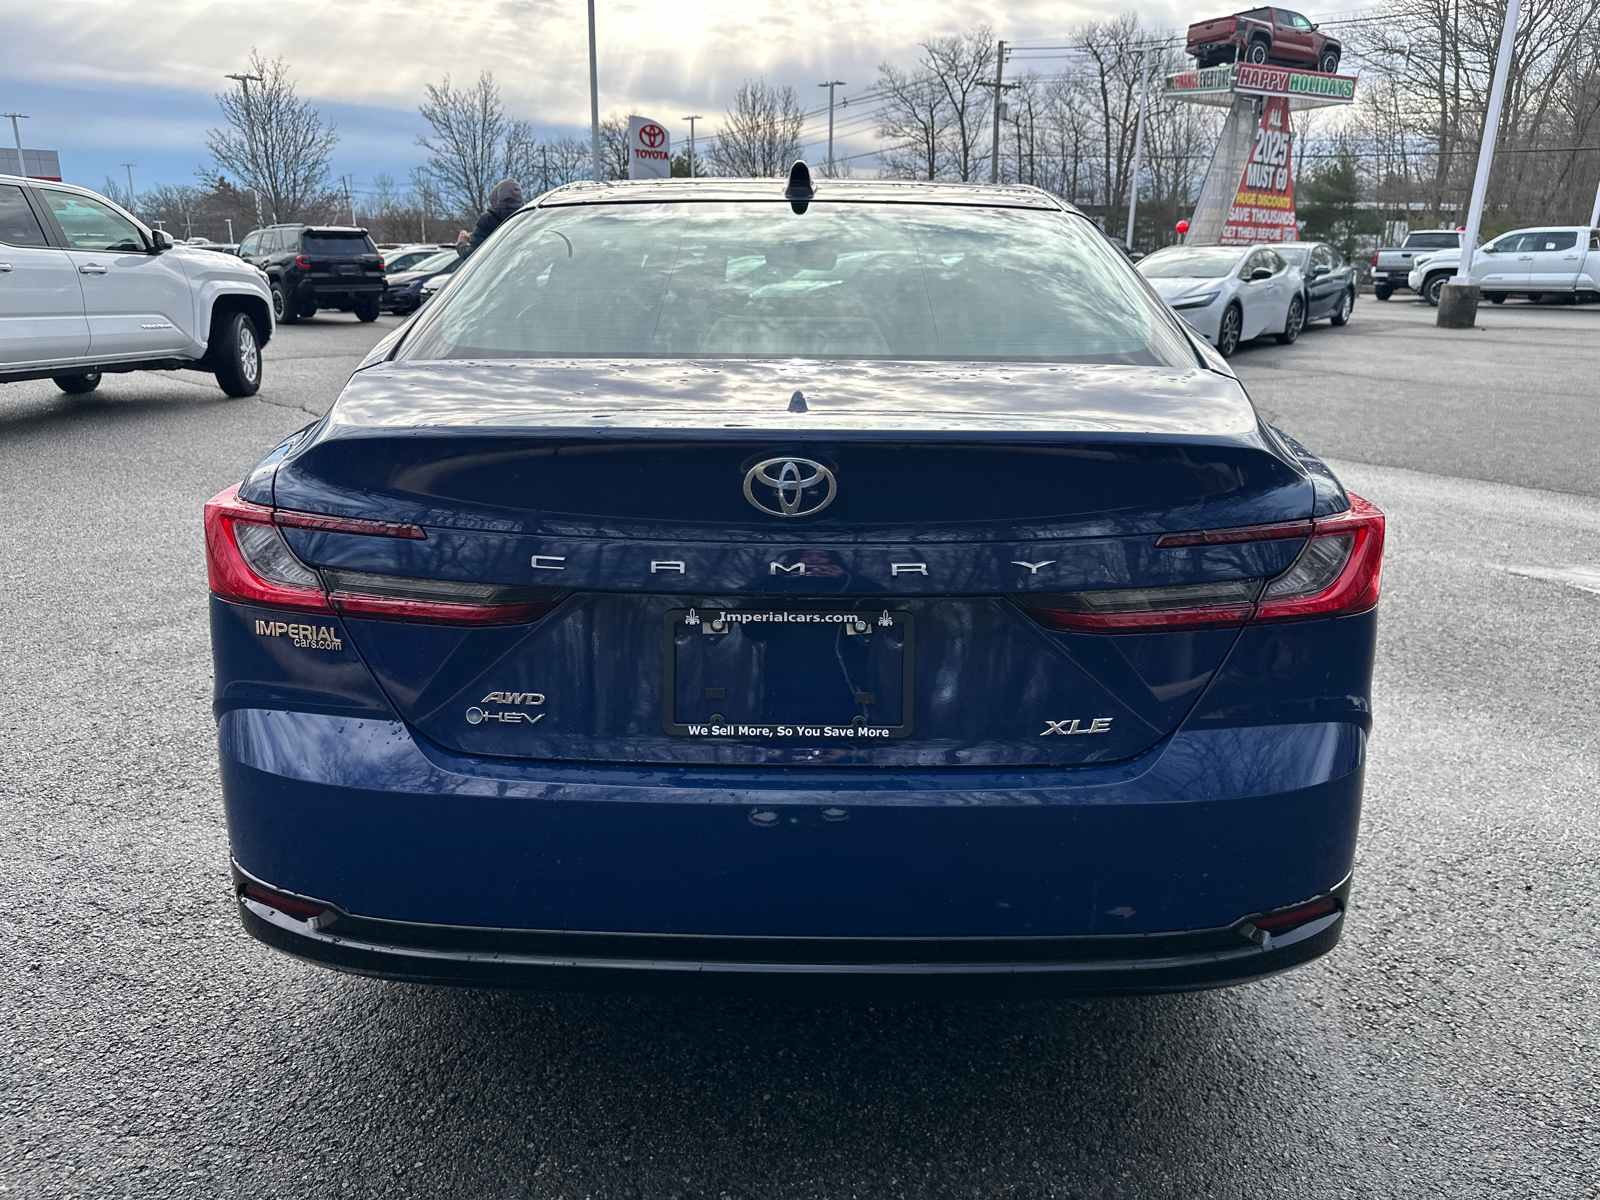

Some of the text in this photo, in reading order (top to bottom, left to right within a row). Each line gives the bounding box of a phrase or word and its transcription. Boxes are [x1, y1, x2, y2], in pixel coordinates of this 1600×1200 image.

[1238, 67, 1353, 97] HAPPY HOLIDAYS
[1269, 108, 1282, 127] ALL
[635, 149, 669, 160] TOYOTA
[1253, 128, 1289, 166] 2025
[1246, 163, 1288, 191] MUST GO
[1236, 192, 1291, 209] HUGE DISCOUNTS
[1228, 207, 1251, 222] SAVE
[1251, 207, 1296, 226] THOUSANDS
[1222, 226, 1237, 238] GET
[1237, 226, 1256, 239] THEM
[1257, 228, 1282, 240] BEFORE
[531, 554, 1057, 577] CAMRY
[719, 611, 859, 623] Imperialcars.com
[255, 619, 342, 642] IMPERIAL
[293, 638, 342, 651] cars.com
[481, 691, 546, 706] AWD
[688, 726, 890, 738] We Sell More, So You Save More
[1039, 717, 1114, 736] XLE
